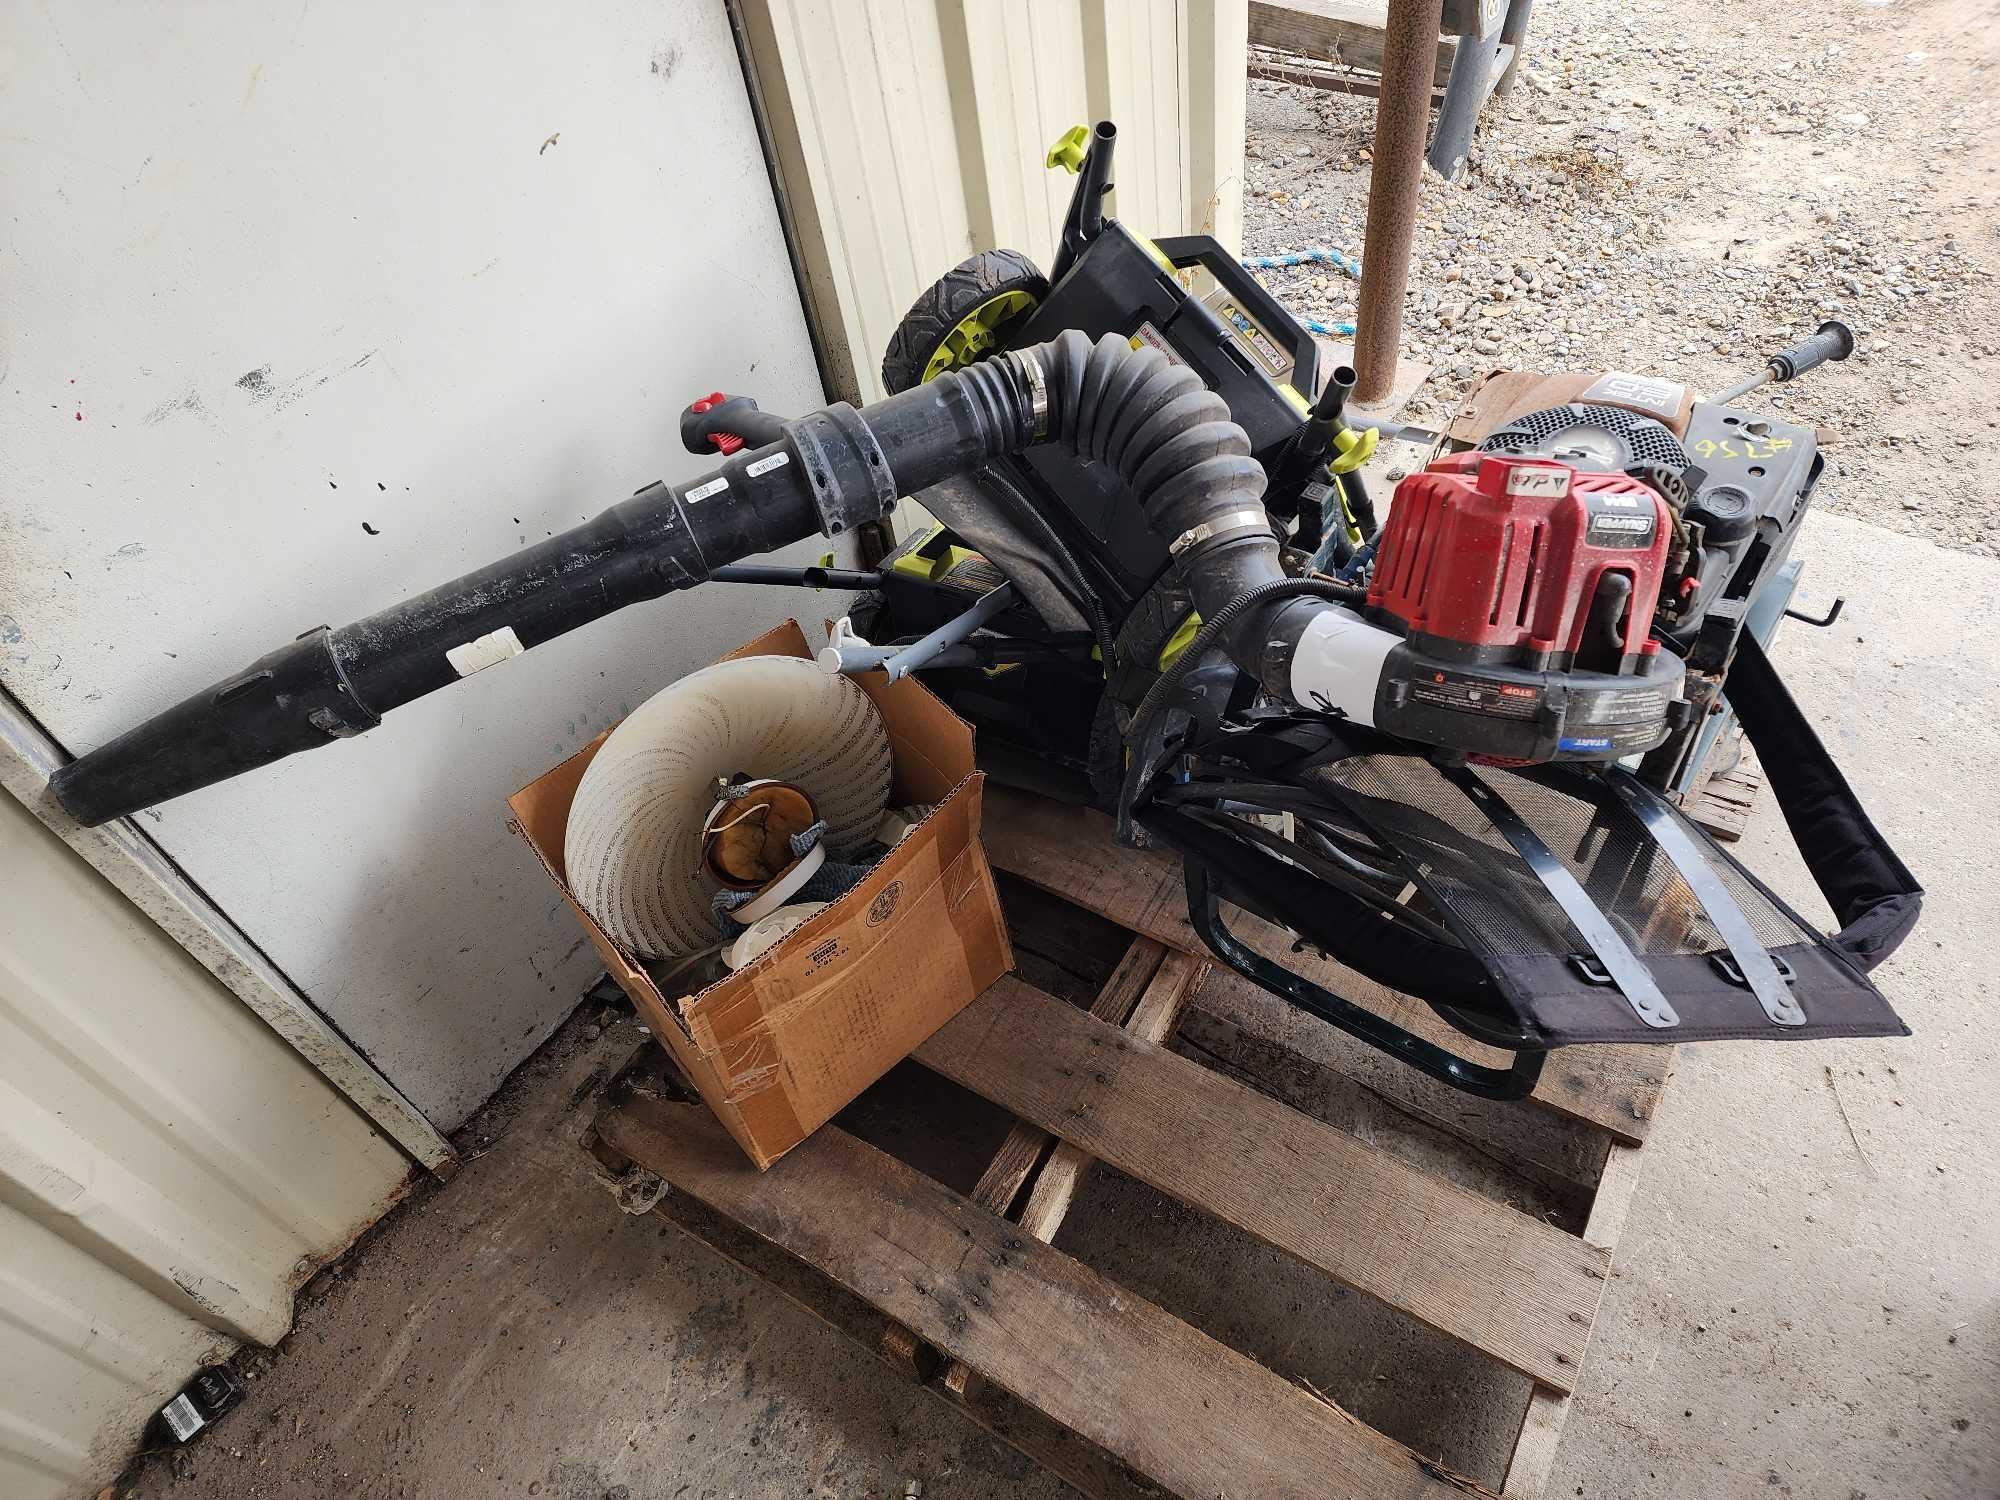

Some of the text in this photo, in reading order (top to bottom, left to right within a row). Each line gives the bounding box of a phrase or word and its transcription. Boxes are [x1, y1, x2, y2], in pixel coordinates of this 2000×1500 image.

[1141, 328, 1160, 349] DANGER
[1602, 389, 1666, 407] INTEK
[1596, 517, 1649, 531] SNAPPER
[1504, 687, 1535, 698] STOP
[1574, 738, 1609, 747] START
